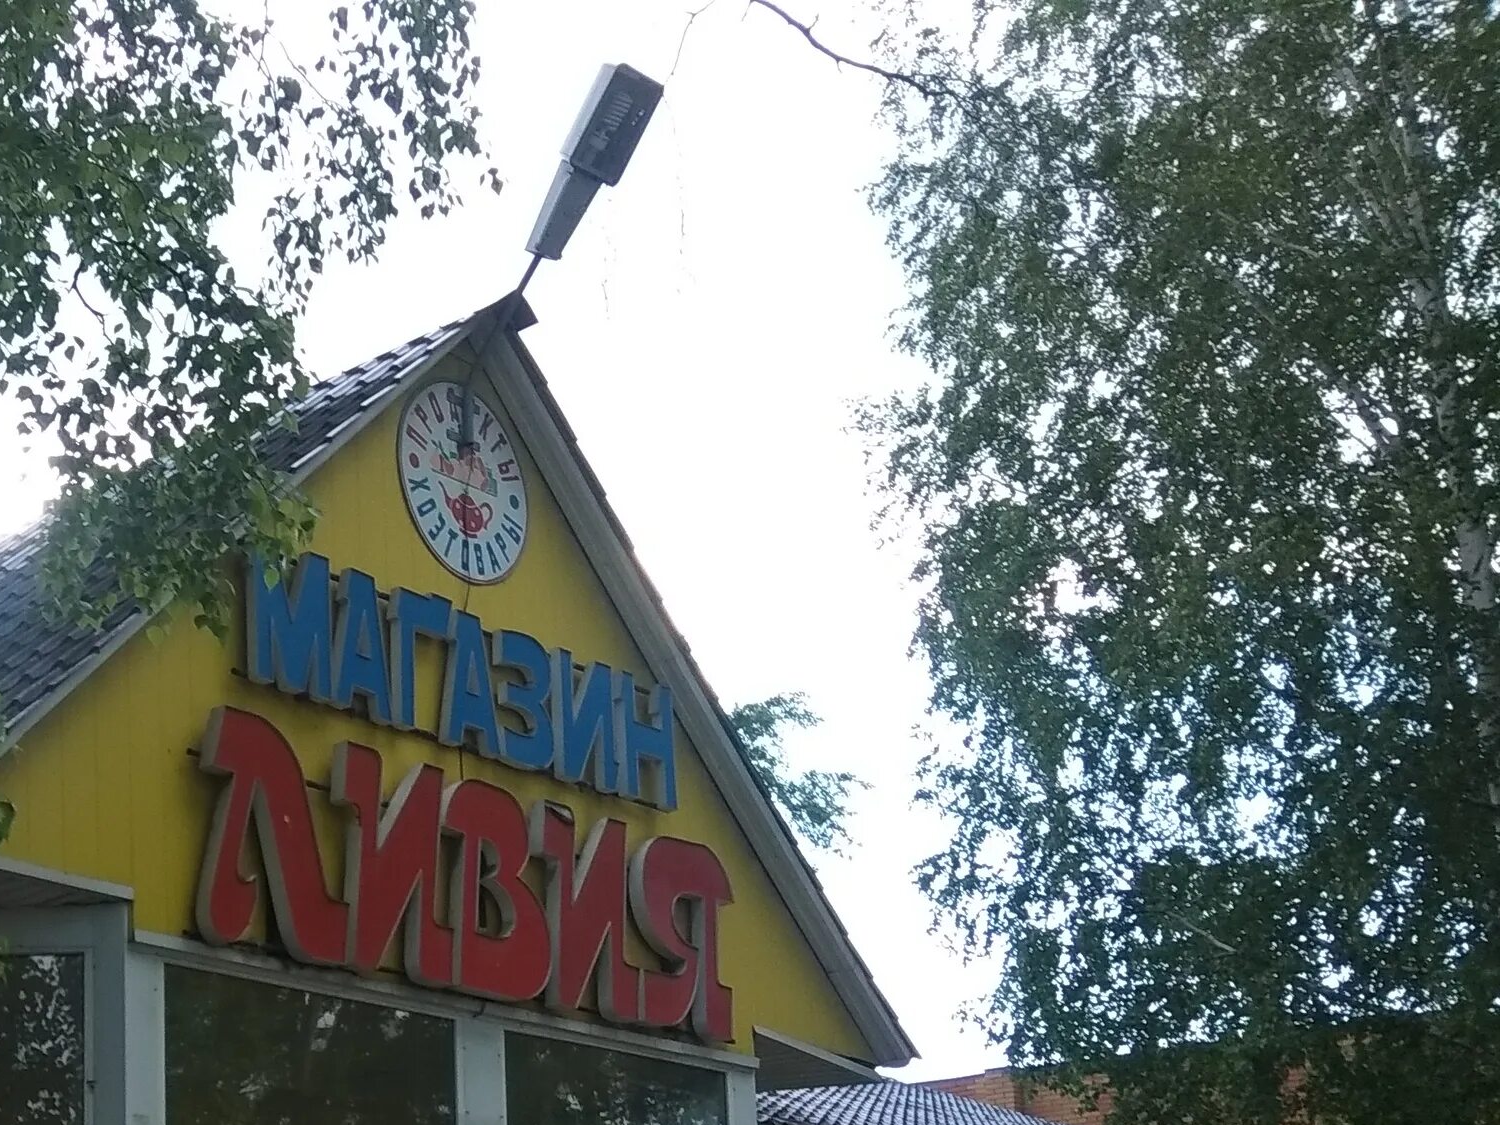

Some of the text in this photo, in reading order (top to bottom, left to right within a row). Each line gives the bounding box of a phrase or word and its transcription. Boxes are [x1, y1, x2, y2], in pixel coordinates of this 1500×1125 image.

[406, 387, 519, 482] ПРОДКТЫ
[408, 477, 523, 576] ХОЗТОВАРЫ
[247, 551, 677, 812] МАГАЗИН
[196, 706, 734, 1043] ЛИВИЯ
